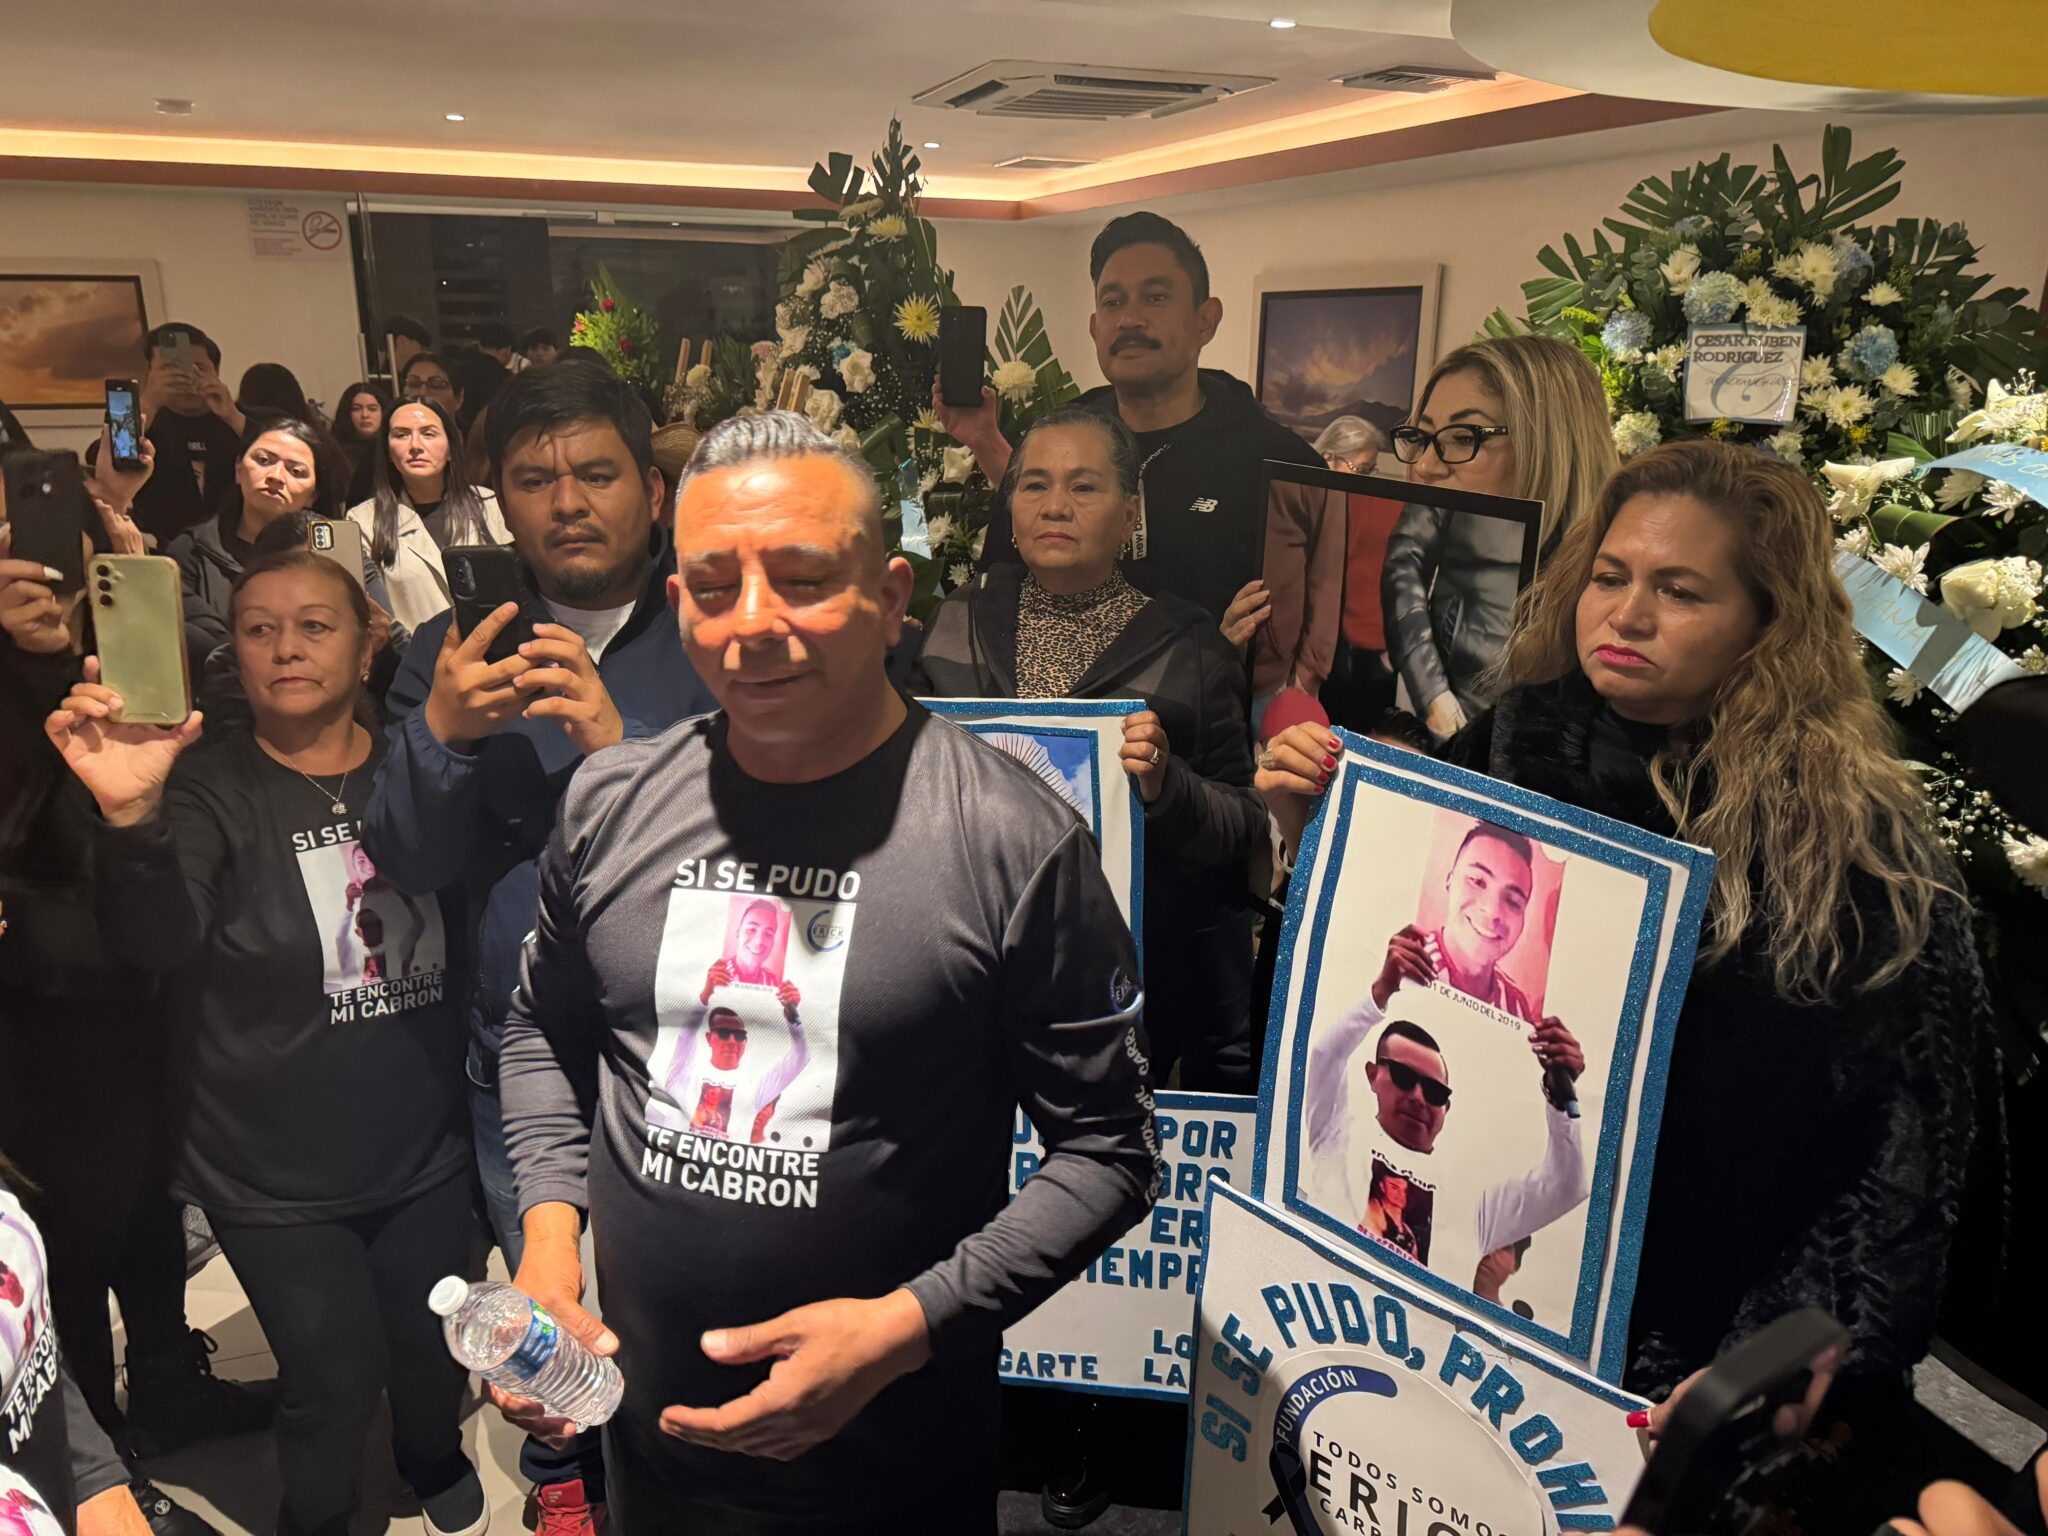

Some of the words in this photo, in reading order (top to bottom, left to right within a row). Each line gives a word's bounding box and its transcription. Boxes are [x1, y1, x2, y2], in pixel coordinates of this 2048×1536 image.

[1692, 350, 1785, 363] RODRIGUEZ
[1694, 334, 1744, 348] CESAR
[1747, 333, 1801, 348] RUBEN
[1136, 534, 1144, 558] new
[292, 831, 316, 851] SI
[321, 823, 352, 845] SE
[673, 858, 706, 888] SI
[714, 860, 755, 891] SE
[766, 863, 861, 900] PUDO
[330, 990, 352, 1008] TE
[356, 971, 443, 1001] ENCONTRE
[330, 1006, 355, 1024] MI
[361, 985, 444, 1018] CABRON
[1453, 993, 1479, 1012] JUNIO
[1480, 1005, 1496, 1020] DEL
[1497, 1013, 1521, 1031] 2019
[646, 1124, 672, 1152] TE
[676, 1134, 820, 1177] ENCONTRE
[1155, 1115, 1237, 1160] POR
[641, 1148, 673, 1184] MI
[680, 1162, 819, 1209] CABRON
[1211, 1311, 1273, 1396] SE
[5, 1388, 26, 1425] TE
[1276, 1367, 1358, 1444] FUNDACIÓN
[8, 1407, 33, 1454] MI
[1201, 1392, 1252, 1462] SI
[1313, 1431, 1397, 1490] TODOS
[1411, 1486, 1508, 1536] SOMO
